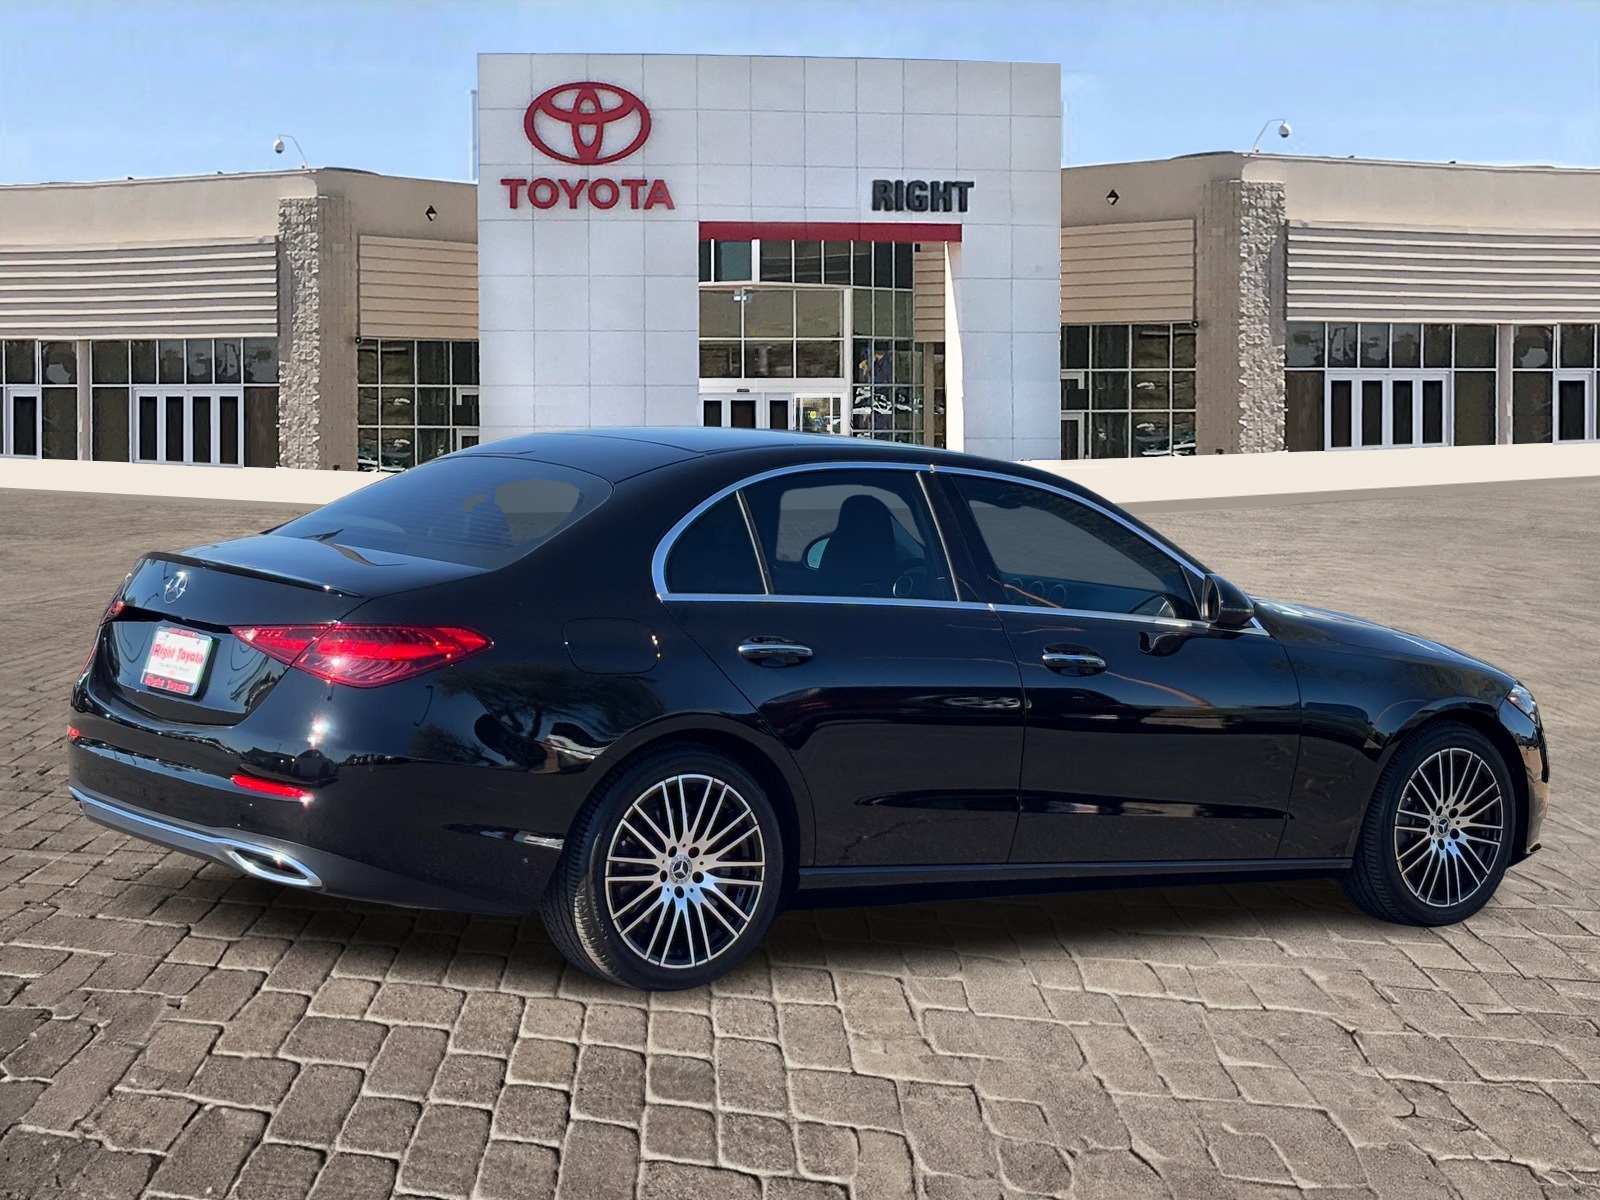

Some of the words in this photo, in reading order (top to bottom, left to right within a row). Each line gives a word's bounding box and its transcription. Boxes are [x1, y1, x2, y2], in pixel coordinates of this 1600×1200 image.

[500, 178, 675, 210] TOYOTA
[872, 179, 975, 212] RIGHT
[152, 643, 175, 660] Right
[176, 647, 205, 665] Toyota
